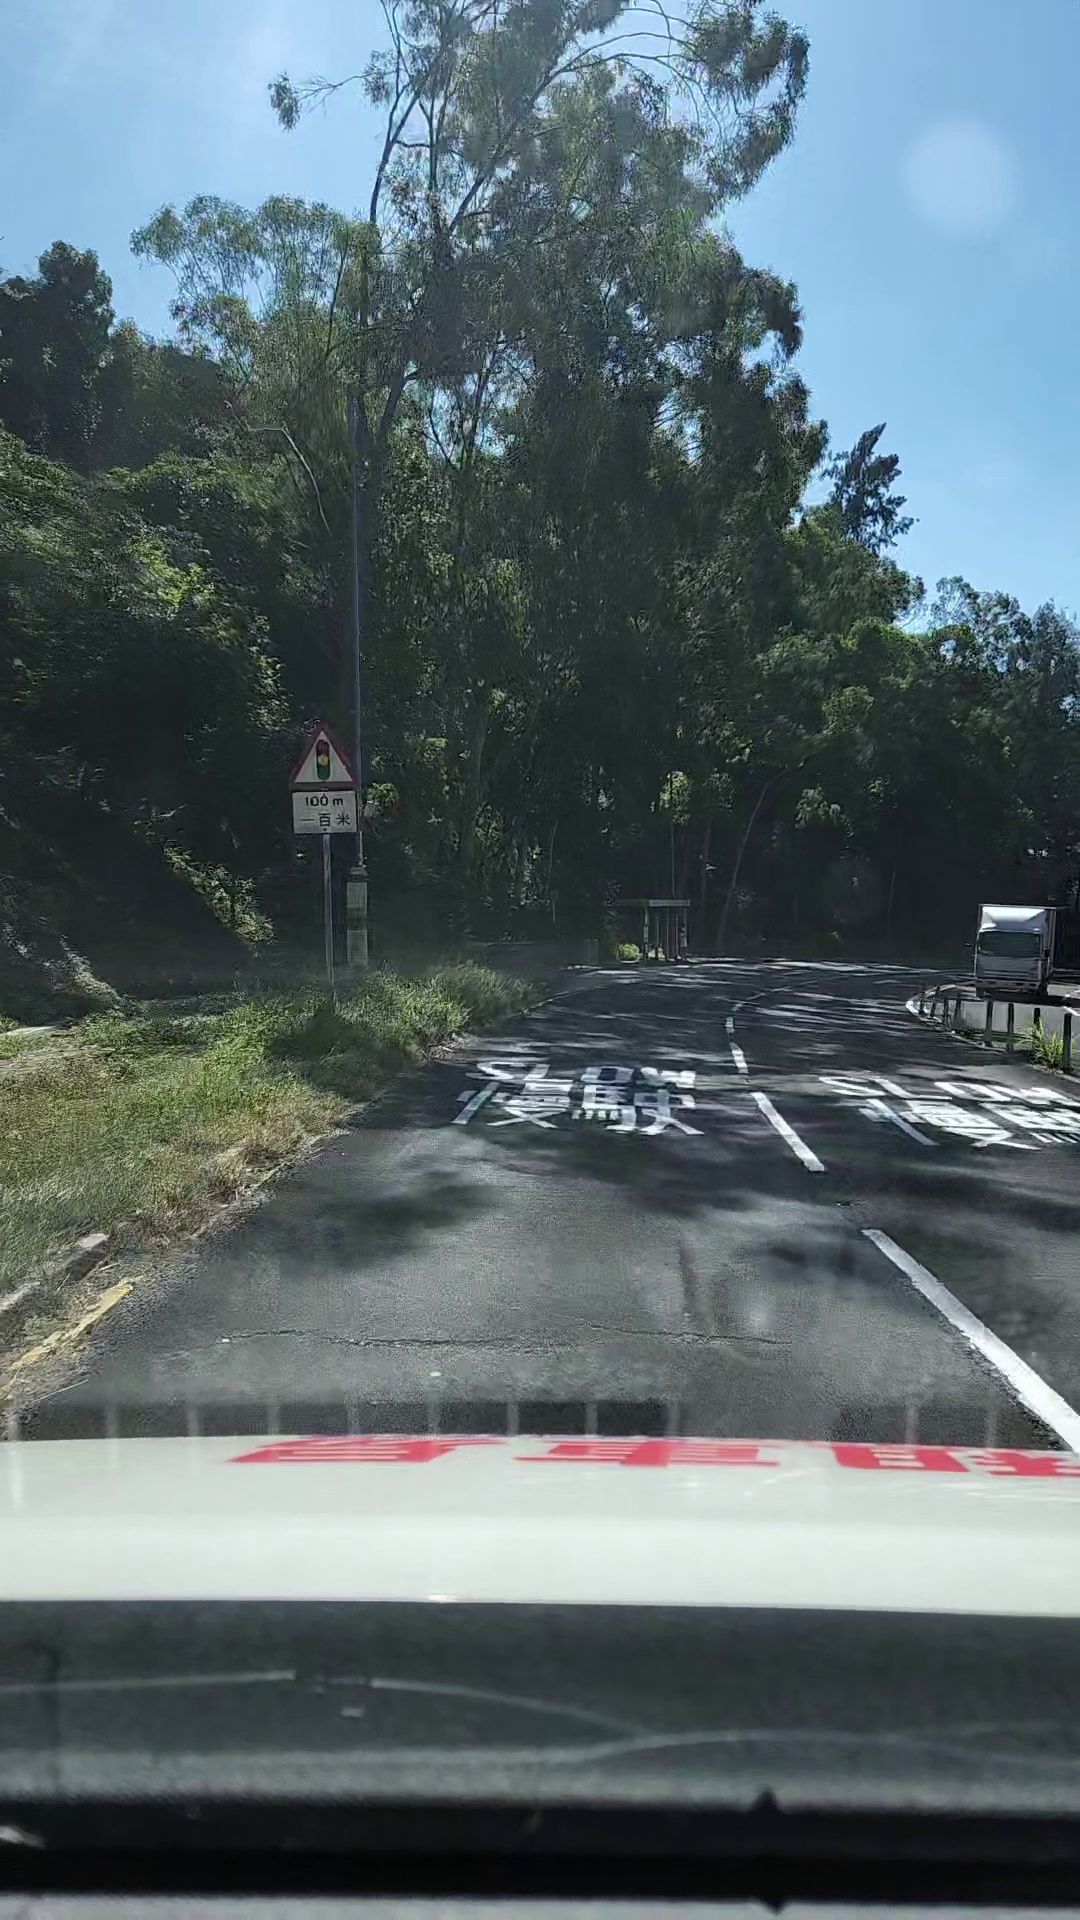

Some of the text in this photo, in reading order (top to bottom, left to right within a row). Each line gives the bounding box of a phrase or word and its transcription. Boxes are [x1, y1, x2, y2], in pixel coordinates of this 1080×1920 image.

[305, 796, 344, 807] 100 m
[299, 812, 352, 827] 一百米
[465, 1061, 697, 1089] SLOW
[818, 1075, 1080, 1107] SLOW
